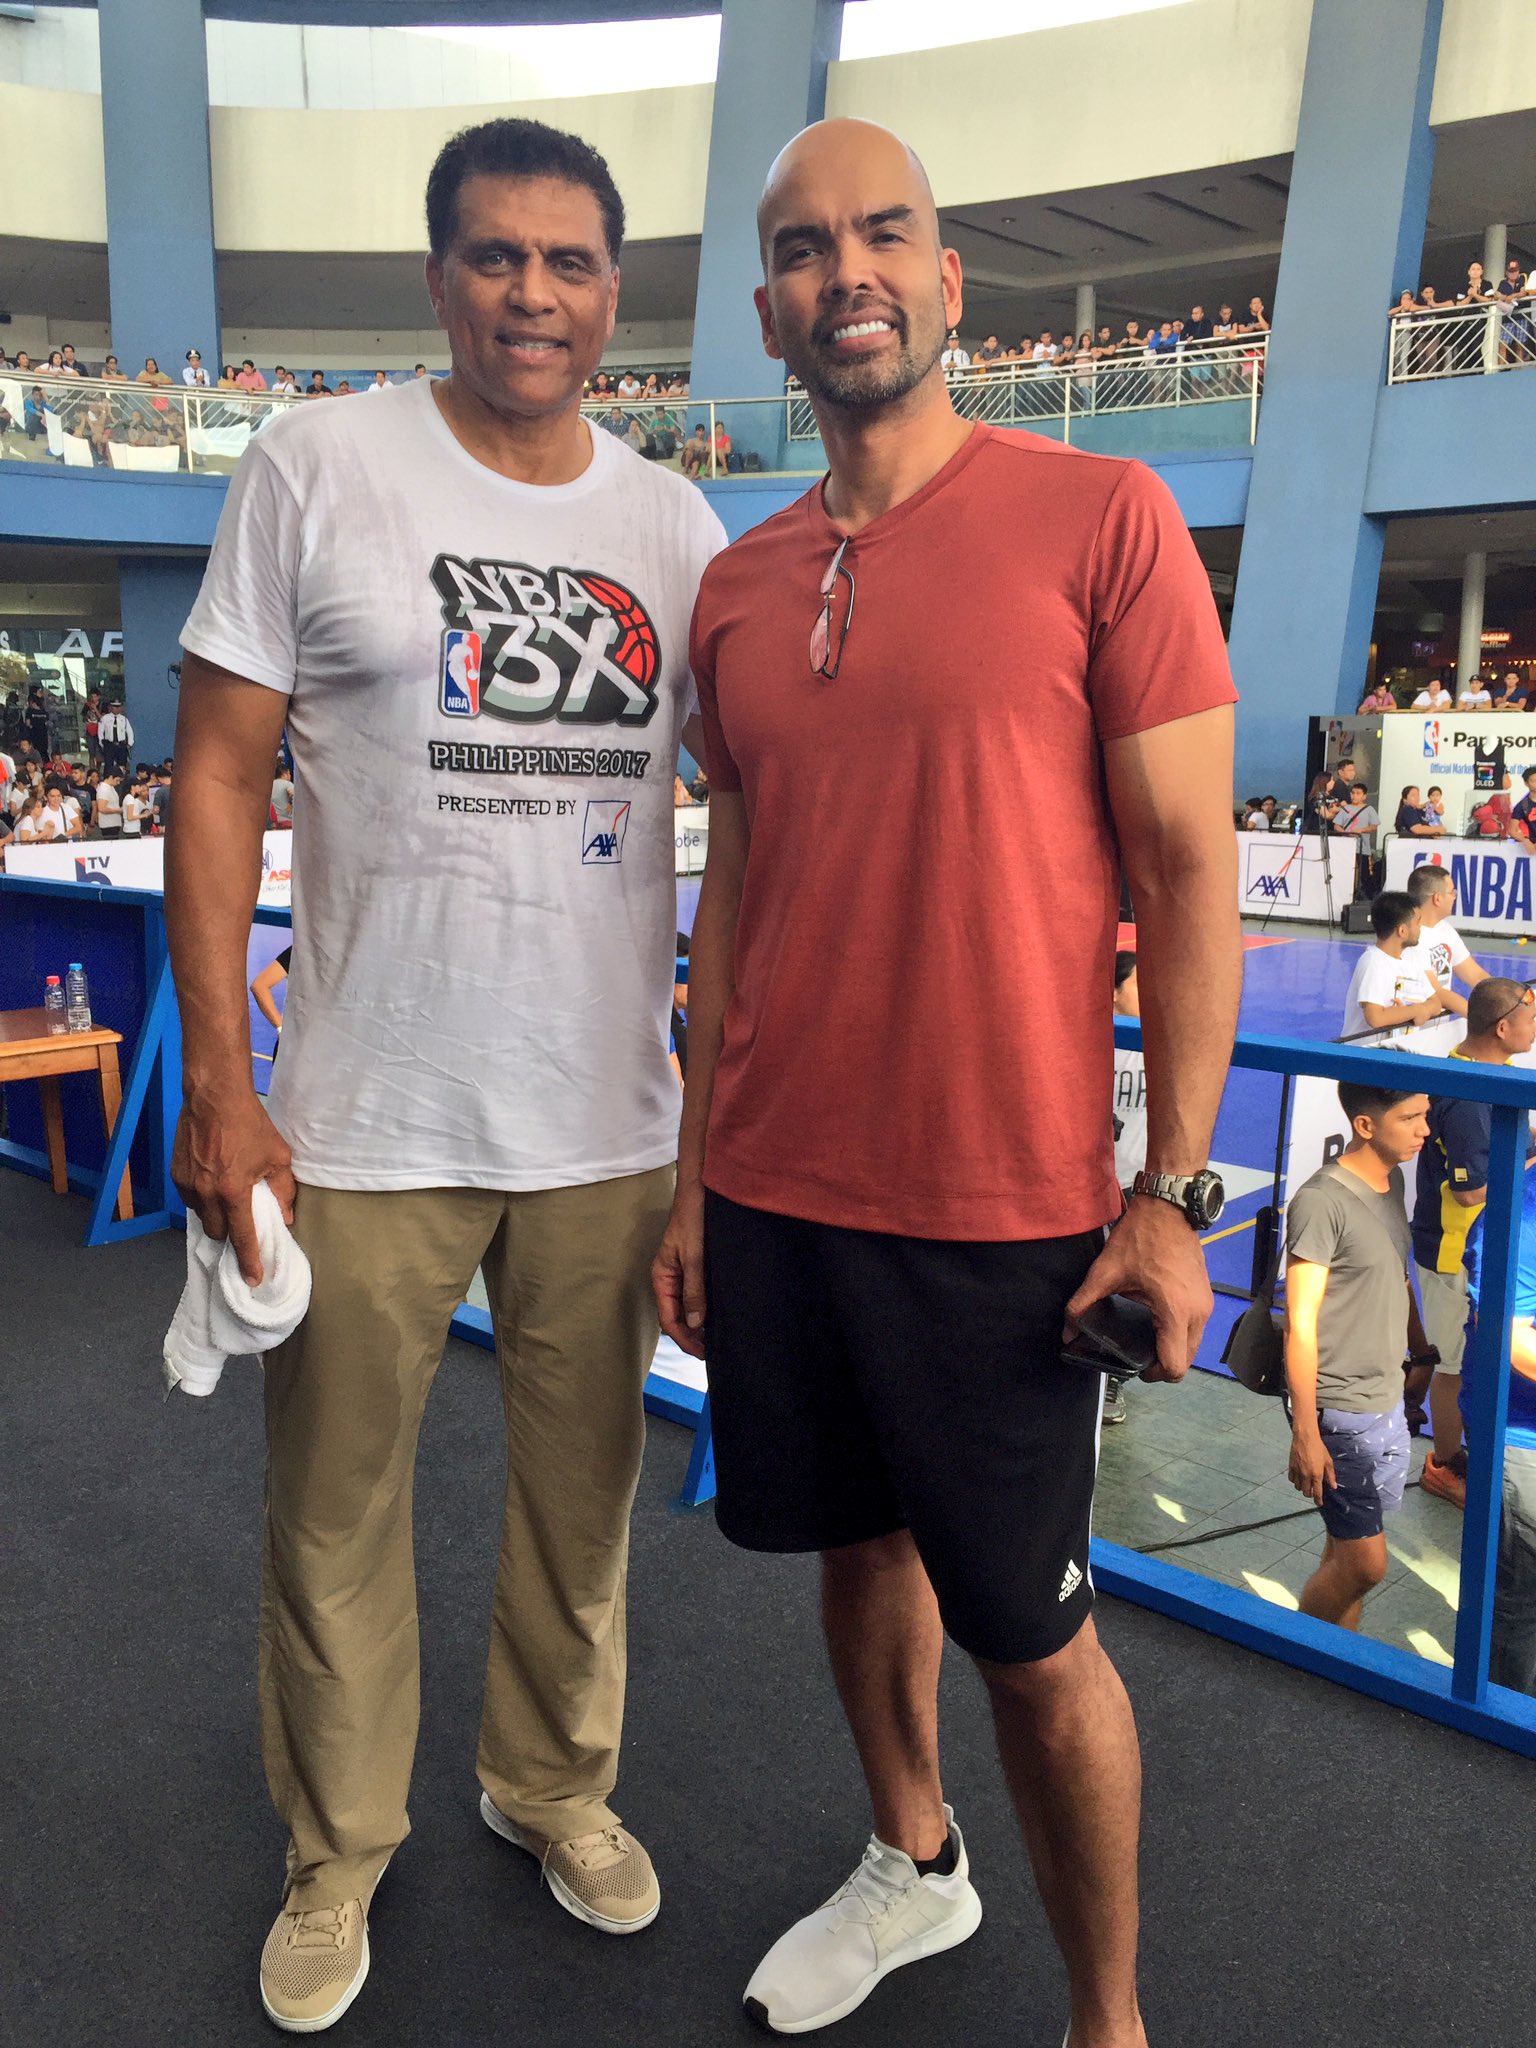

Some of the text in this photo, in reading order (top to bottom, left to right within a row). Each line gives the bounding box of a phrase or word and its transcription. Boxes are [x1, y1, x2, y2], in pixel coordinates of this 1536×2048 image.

[443, 558, 613, 619] NBA
[465, 609, 650, 716] 3X
[447, 696, 469, 709] NBA
[431, 743, 648, 776] PHILIPPINES 2017
[437, 795, 576, 815] PRESENTED BY
[583, 833, 619, 857] AXA
[676, 832, 700, 848] obe
[87, 855, 110, 869] TV
[269, 869, 292, 882] AS
[1247, 875, 1290, 898] AXA
[1451, 854, 1532, 921] NBA
